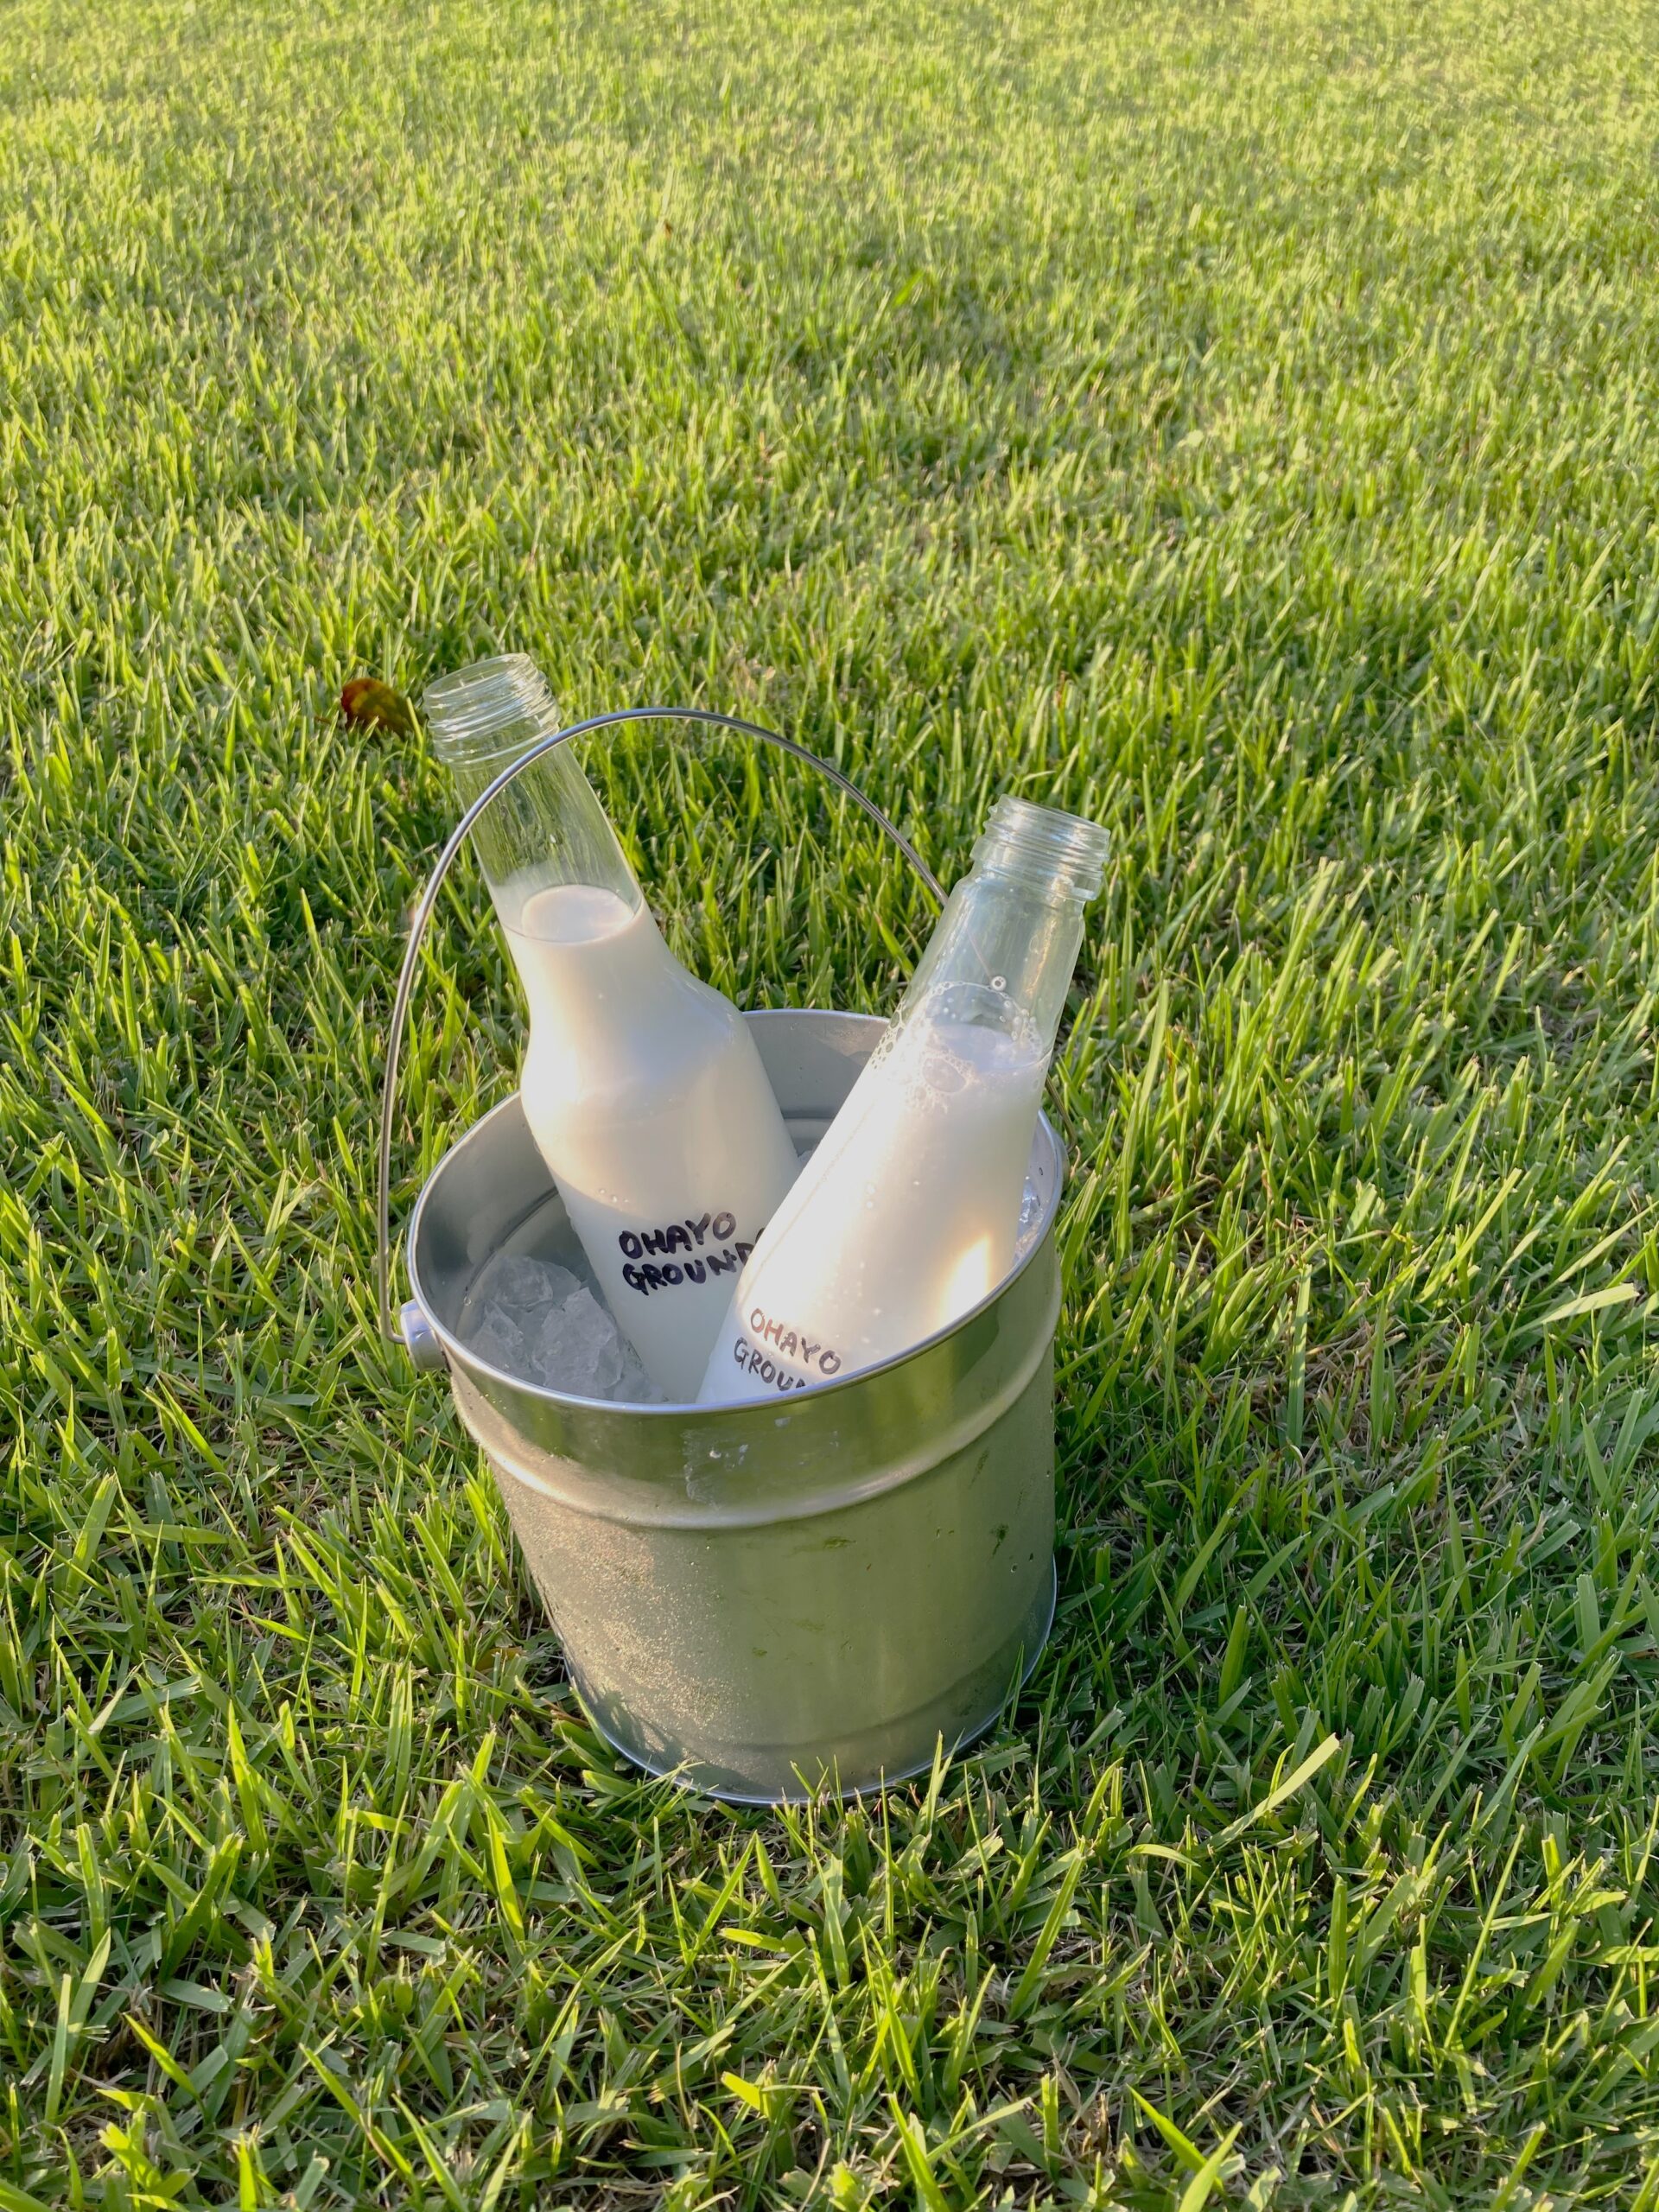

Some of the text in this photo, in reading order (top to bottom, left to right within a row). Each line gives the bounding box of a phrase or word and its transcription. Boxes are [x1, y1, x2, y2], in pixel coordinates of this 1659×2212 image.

[619, 1211, 737, 1260] OHAYO
[622, 1228, 766, 1296] GROUND
[750, 1307, 842, 1375] OHAYO
